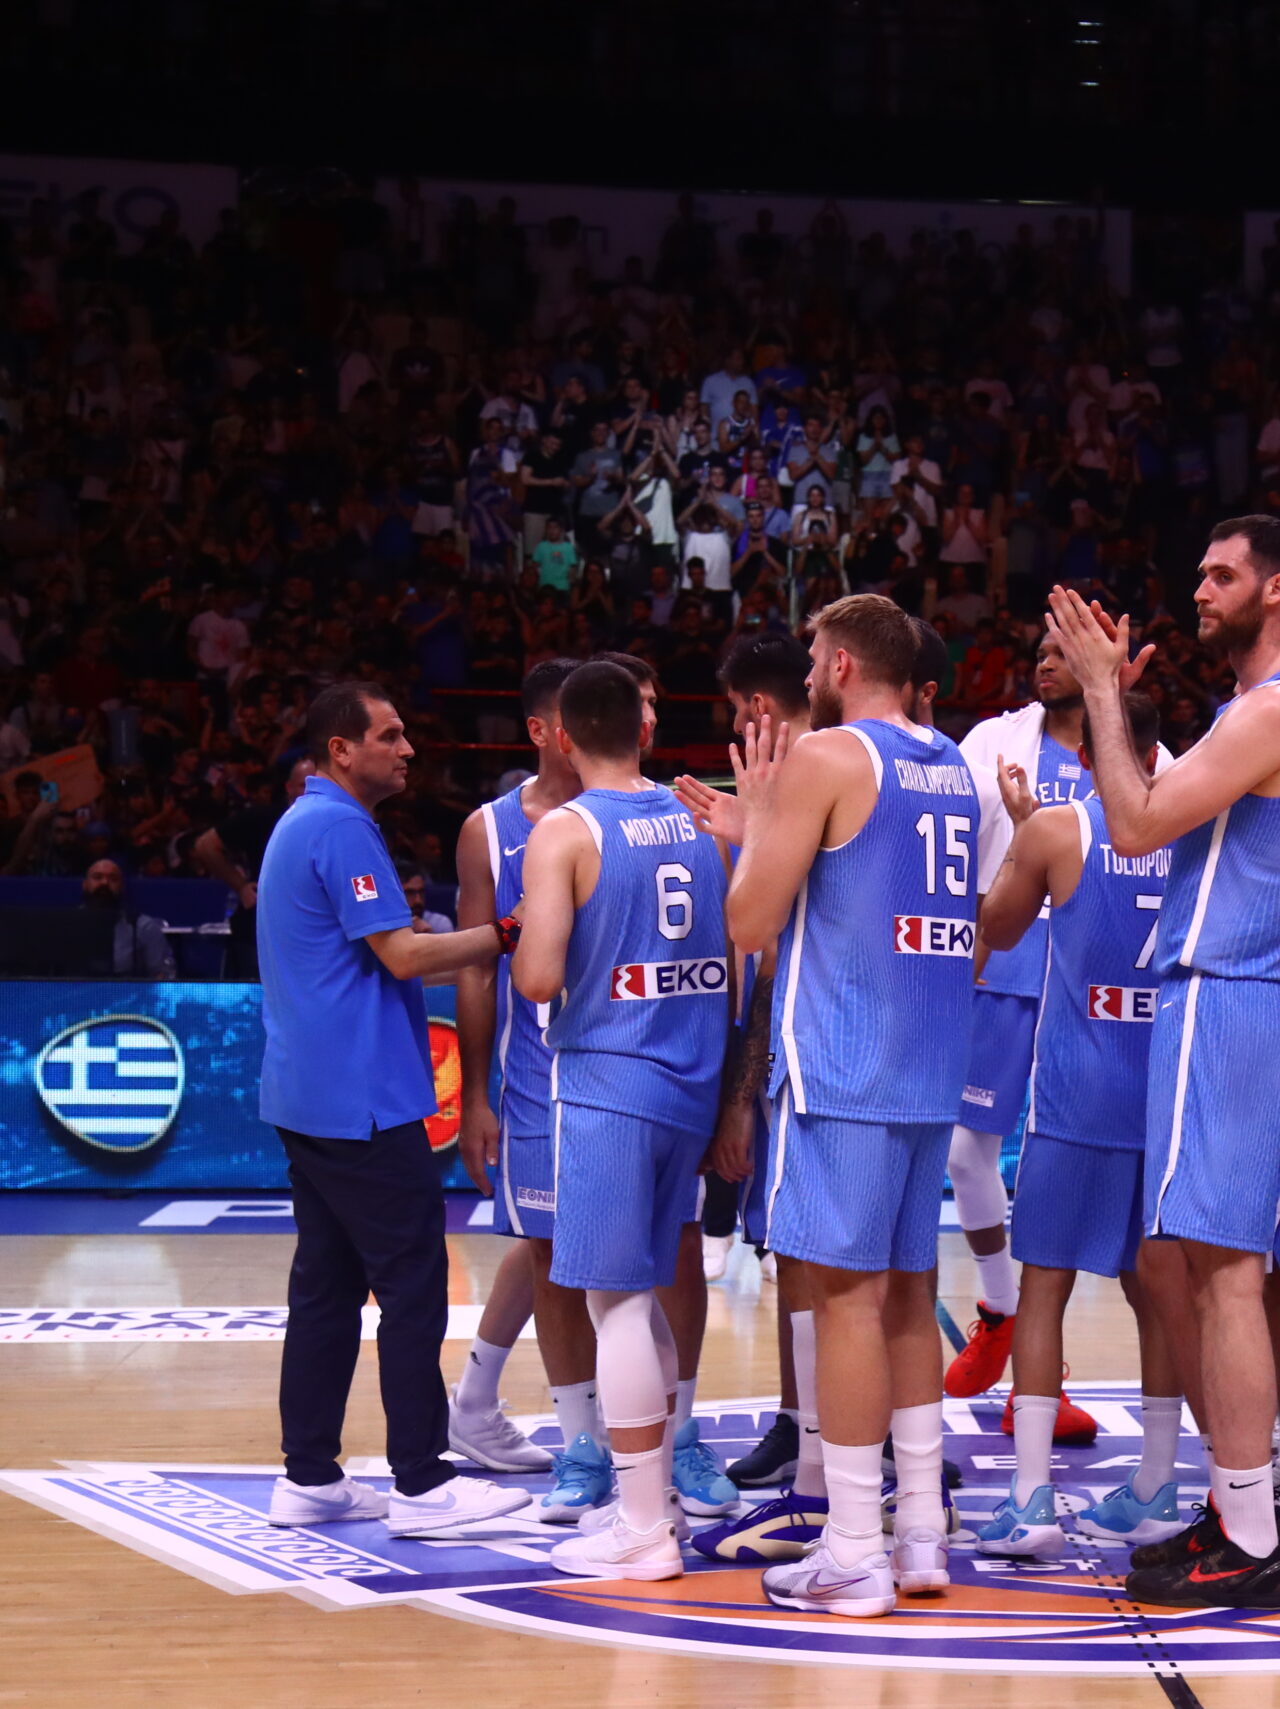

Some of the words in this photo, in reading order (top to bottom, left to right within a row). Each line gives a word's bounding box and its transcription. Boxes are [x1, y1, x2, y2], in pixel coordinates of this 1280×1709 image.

[619, 812, 697, 848] MORAITIS
[915, 811, 972, 897] 15
[655, 862, 693, 941] 6
[1134, 894, 1162, 970] 7
[656, 960, 727, 994] EKO
